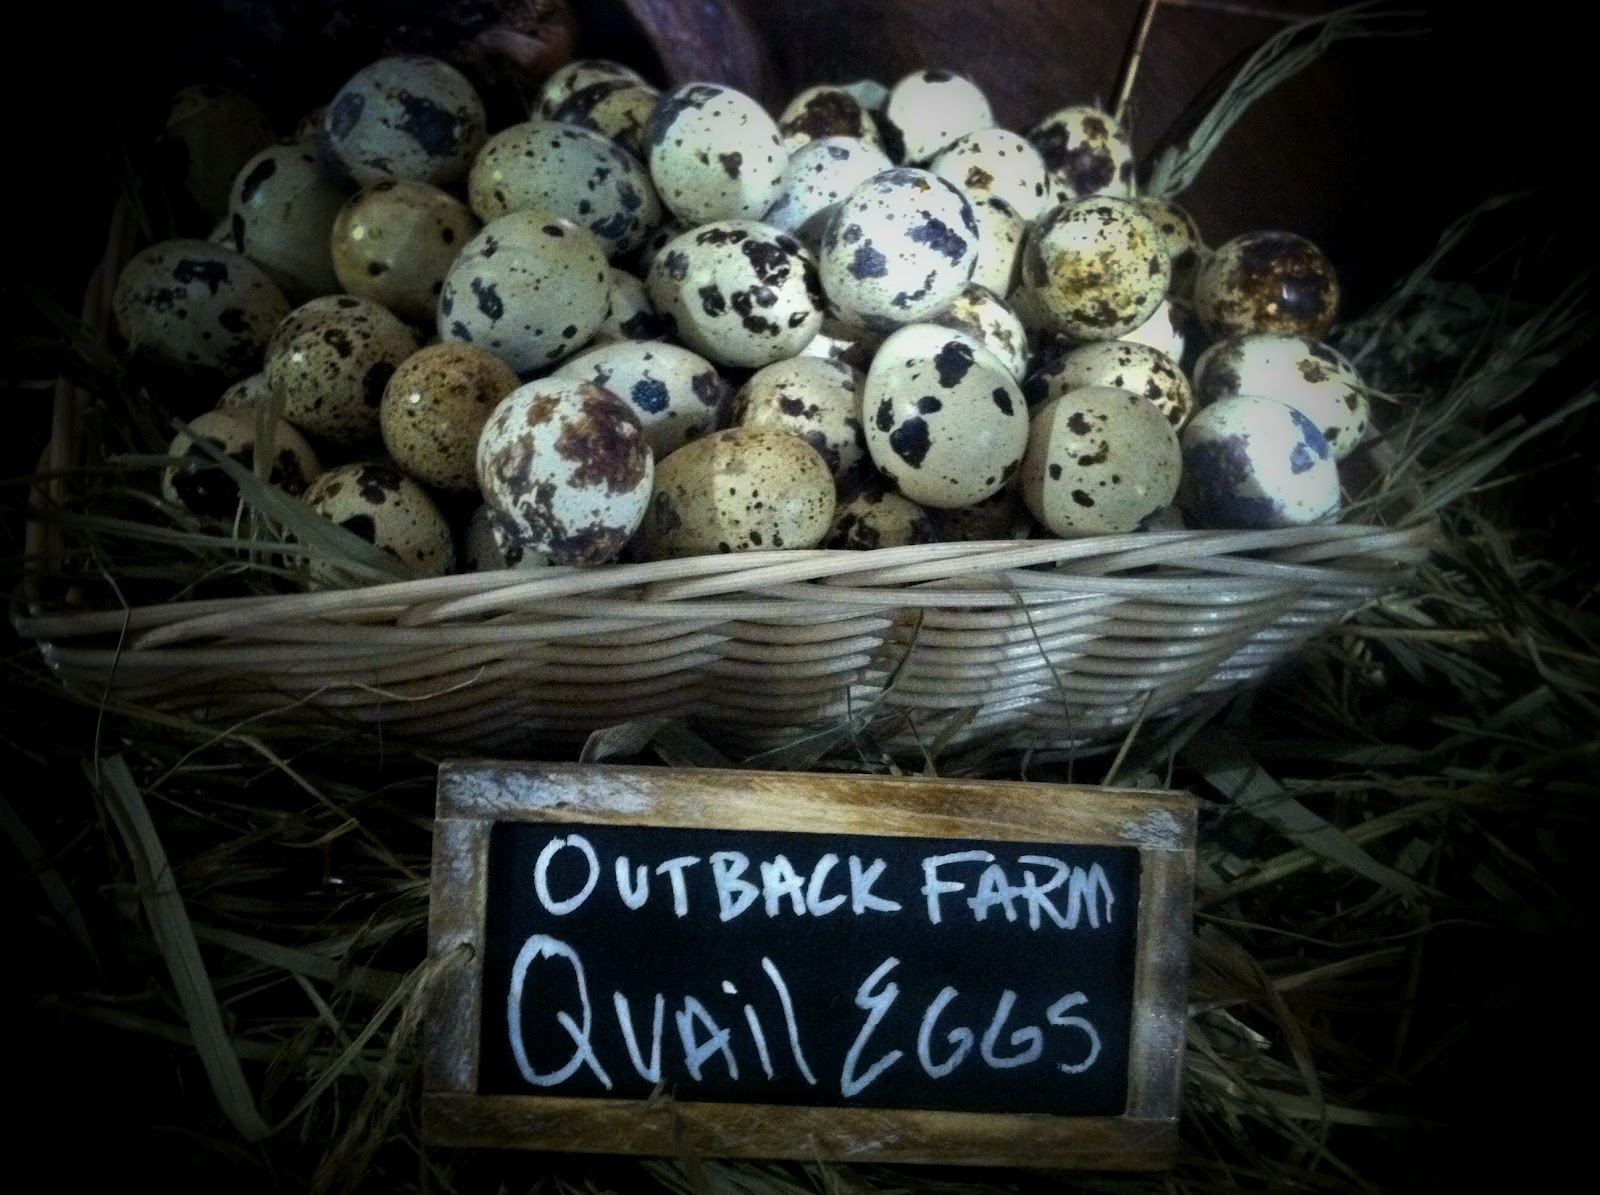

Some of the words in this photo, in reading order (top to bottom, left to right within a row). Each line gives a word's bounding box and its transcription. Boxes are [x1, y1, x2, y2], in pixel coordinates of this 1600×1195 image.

[533, 833, 903, 926] OUTBACK
[920, 849, 1115, 931] FARM
[840, 956, 1102, 1098] EGGS
